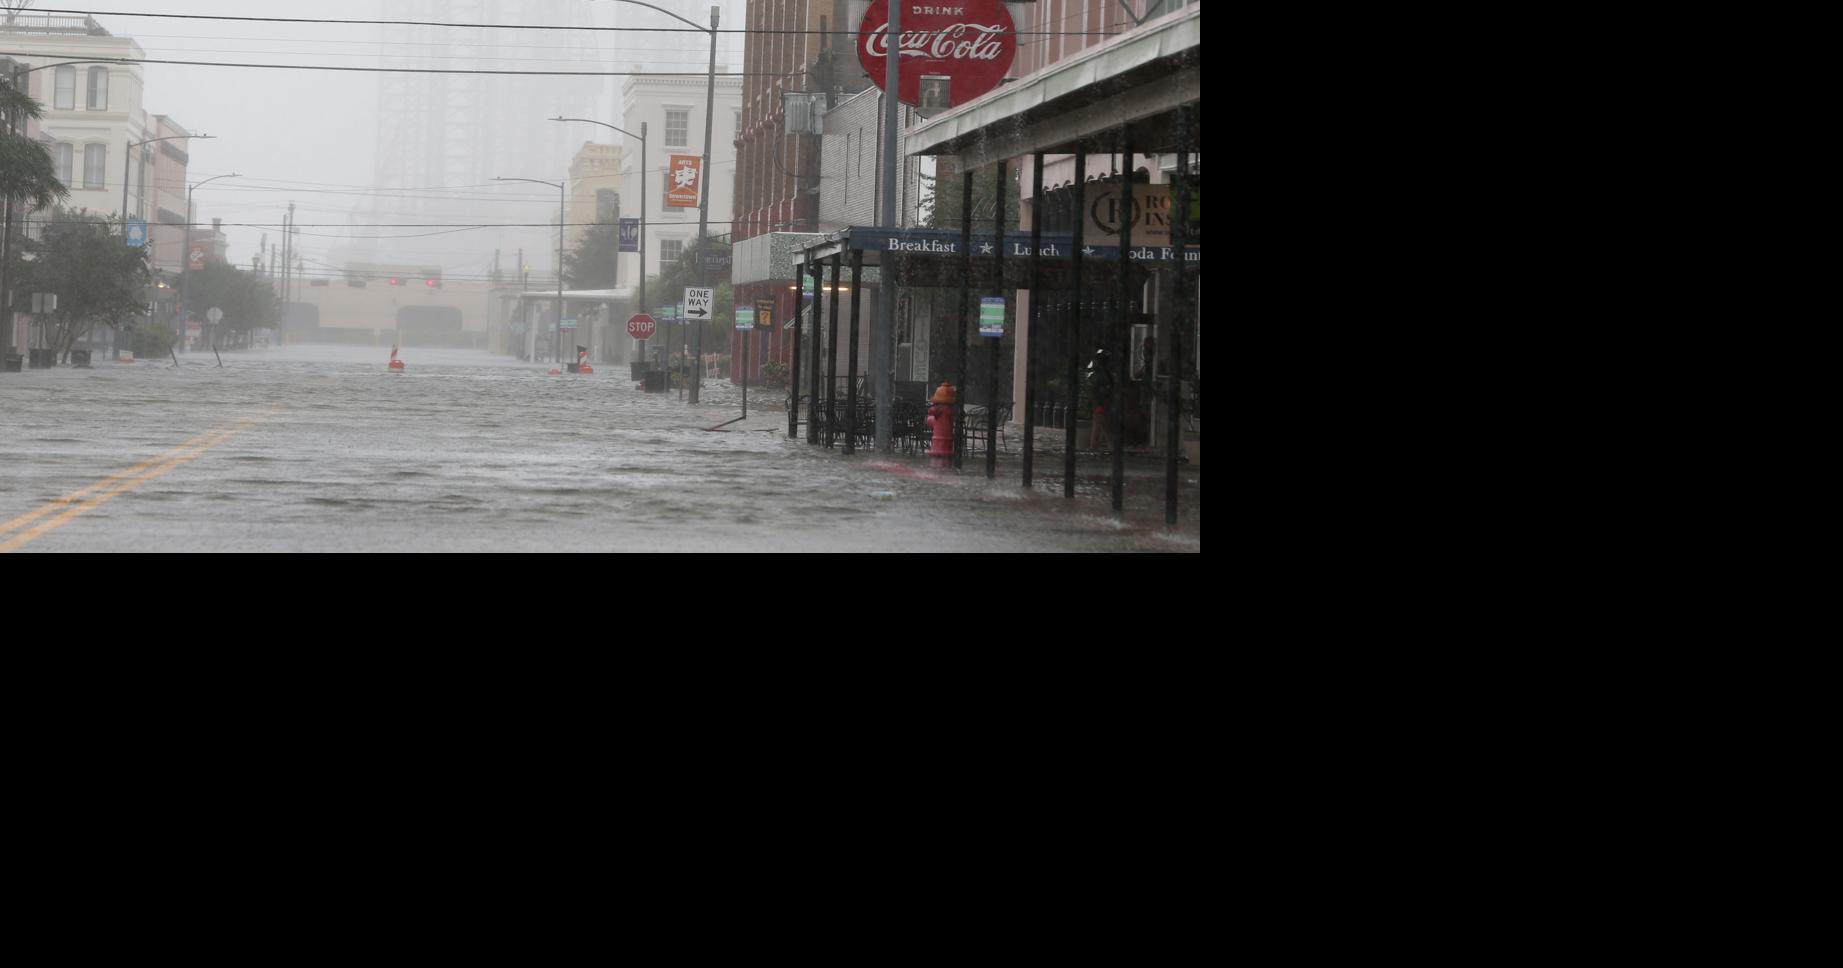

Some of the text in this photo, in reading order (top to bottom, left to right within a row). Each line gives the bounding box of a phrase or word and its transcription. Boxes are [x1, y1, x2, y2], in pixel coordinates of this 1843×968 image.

[912, 6, 965, 16] DRINK
[888, 238, 957, 253] Breakfast
[1129, 246, 1155, 260] oda
[689, 289, 710, 298] ONE
[688, 298, 709, 306] WAY
[628, 322, 655, 332] STOP
